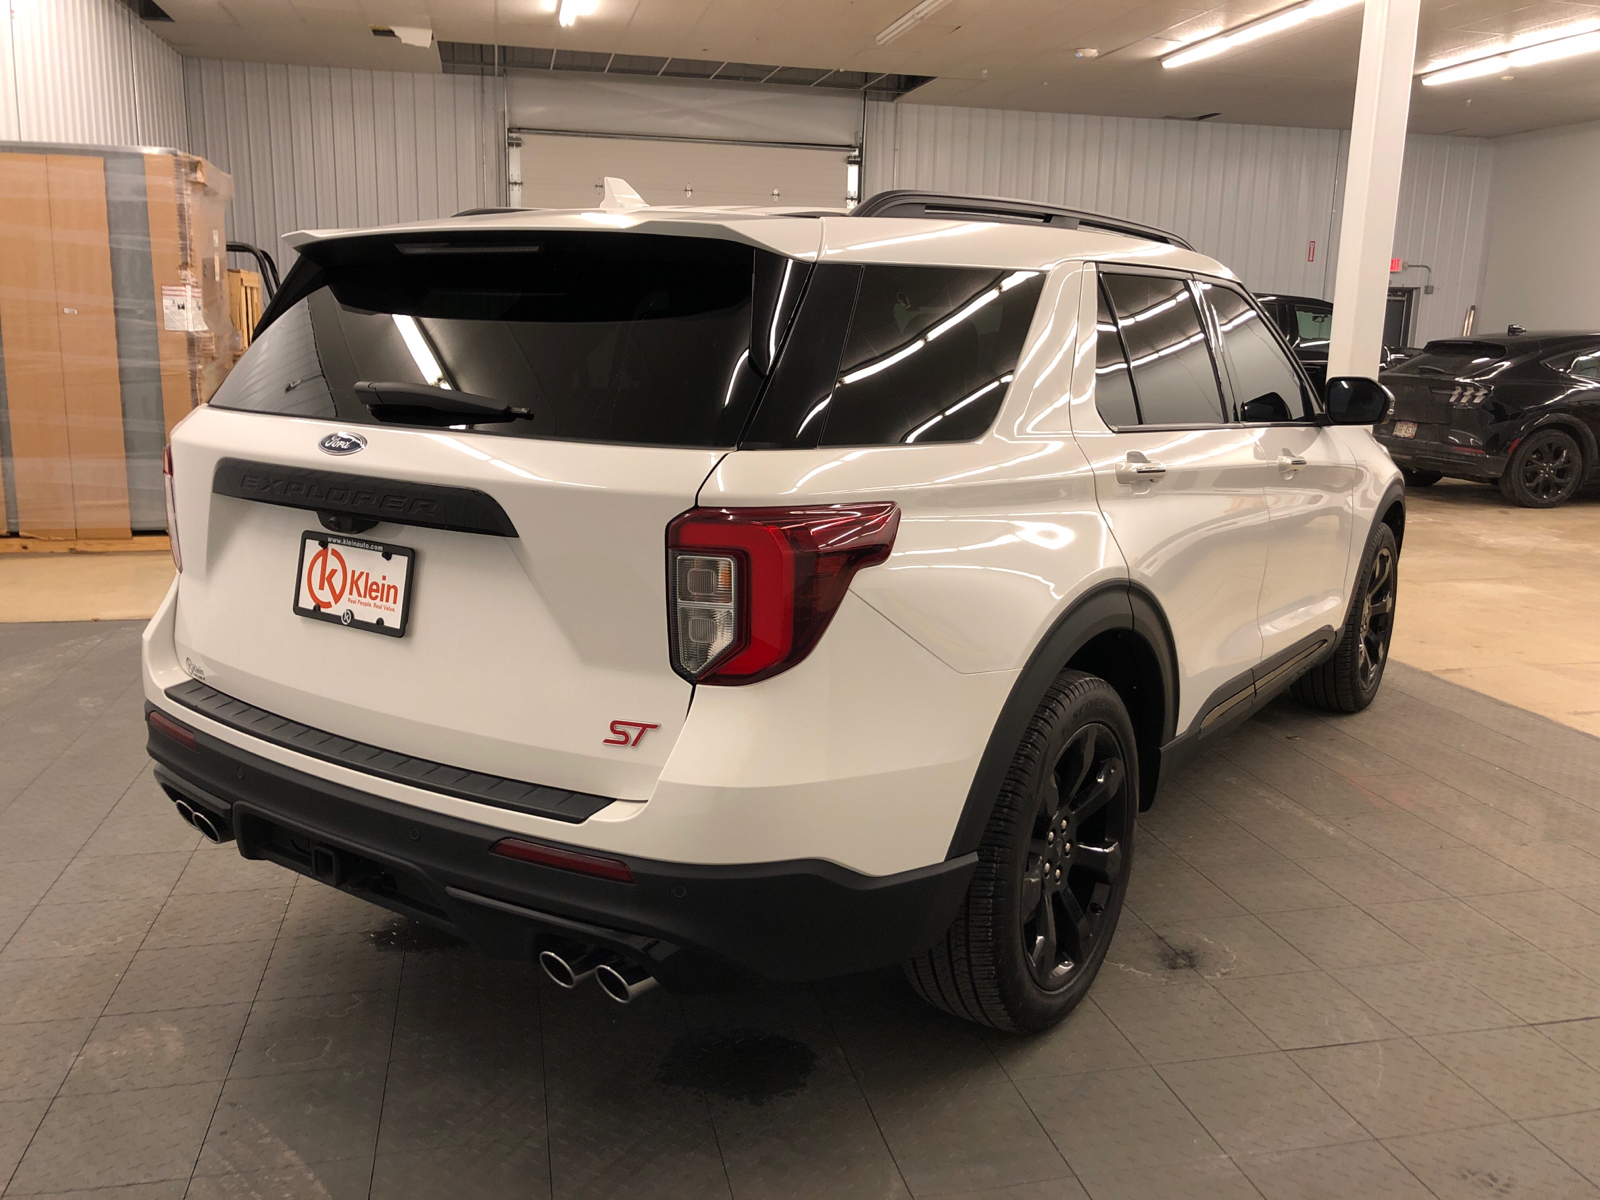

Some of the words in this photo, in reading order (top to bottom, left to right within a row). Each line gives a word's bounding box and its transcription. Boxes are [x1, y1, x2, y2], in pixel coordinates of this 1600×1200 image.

[240, 475, 437, 516] EXPLORER
[327, 536, 384, 551] www.kleinauto.com
[349, 569, 398, 605] Klein
[347, 597, 357, 605] Real
[373, 602, 382, 610] Real
[602, 719, 660, 748] ST
